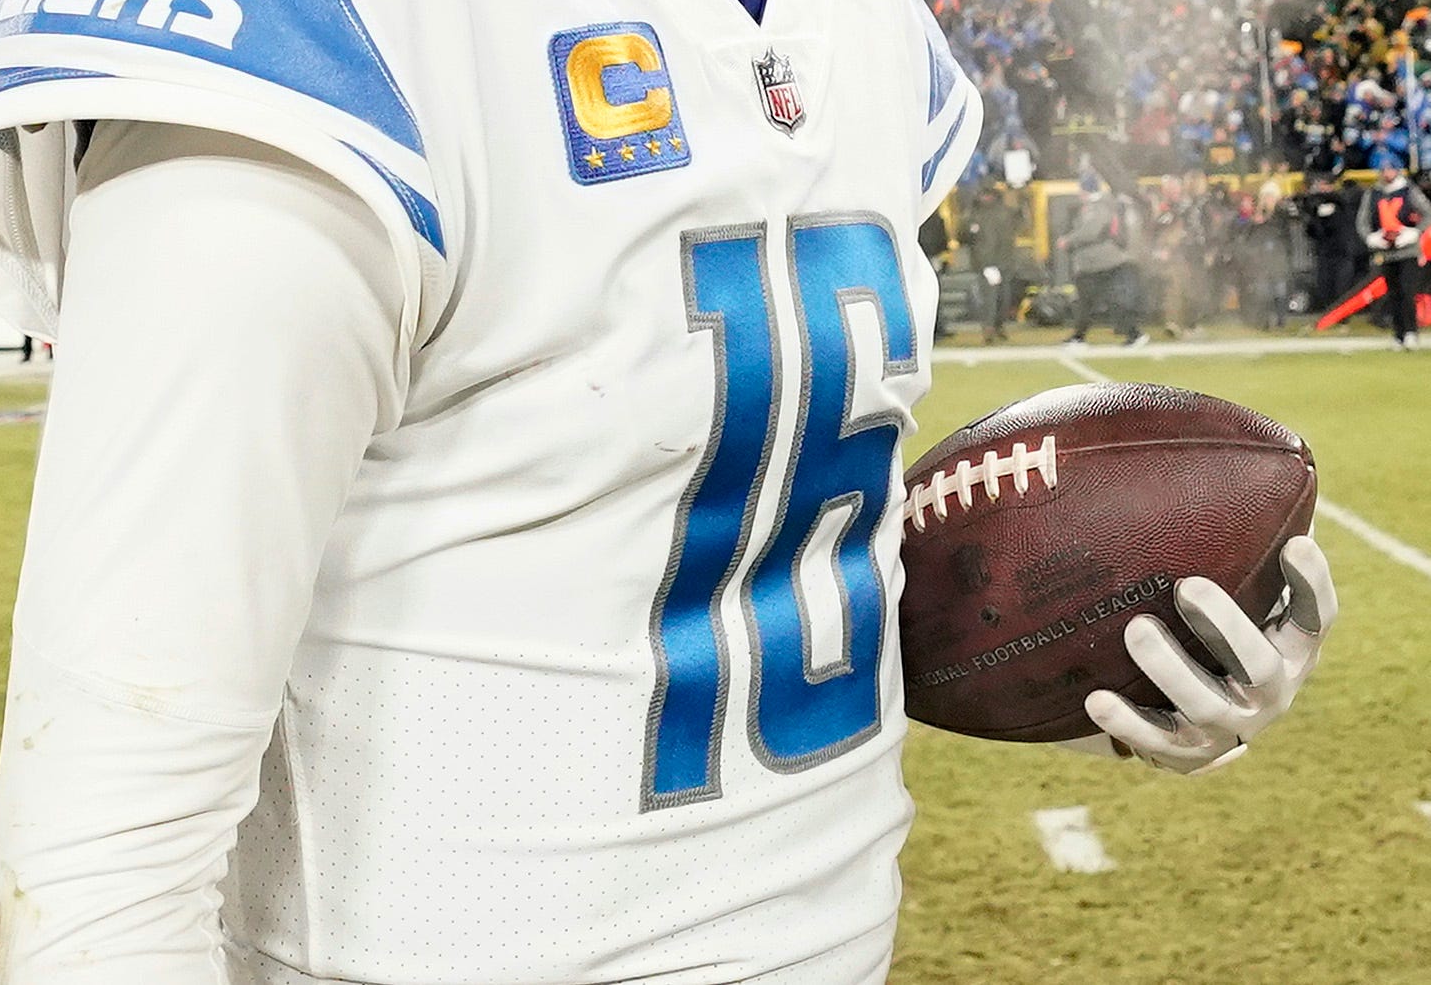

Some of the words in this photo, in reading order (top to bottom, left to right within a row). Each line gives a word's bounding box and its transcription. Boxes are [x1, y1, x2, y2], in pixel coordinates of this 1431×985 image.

[566, 32, 673, 140] C
[769, 87, 802, 121] NFL
[639, 209, 919, 815] 16
[971, 619, 1076, 670] FOOTBALL
[1080, 572, 1171, 625] LEAGUE
